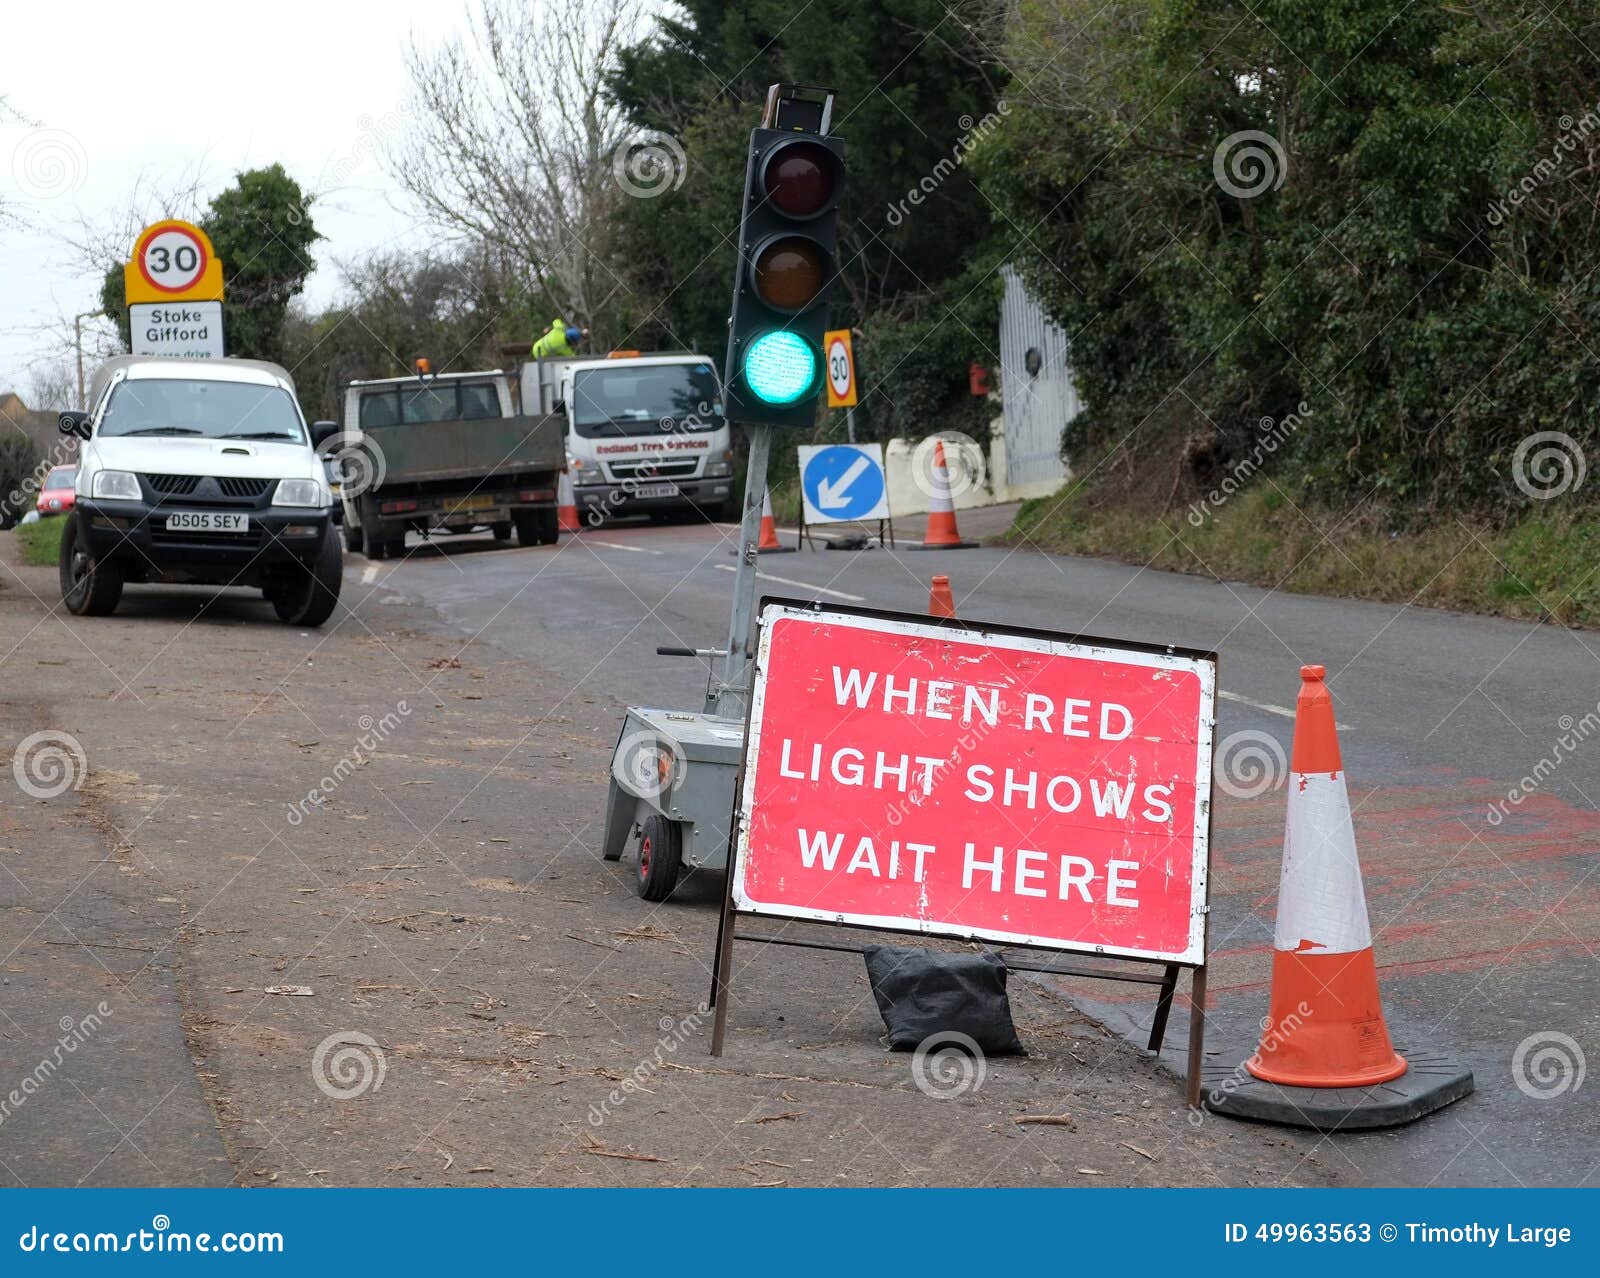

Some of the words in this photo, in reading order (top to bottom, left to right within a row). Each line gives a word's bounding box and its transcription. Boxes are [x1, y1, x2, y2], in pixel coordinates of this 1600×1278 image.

[149, 245, 198, 273] 30
[151, 309, 202, 324] Stoke
[146, 326, 208, 342] Gifford
[831, 356, 848, 381] 30
[172, 514, 209, 528] DS05
[213, 515, 241, 529] SEY
[831, 666, 999, 726] WHEN
[1024, 694, 1134, 742] RED
[779, 738, 945, 797] LIGHT
[963, 764, 1173, 823] SHOWS
[797, 828, 936, 883] WAIT
[961, 842, 1140, 908] HERE
